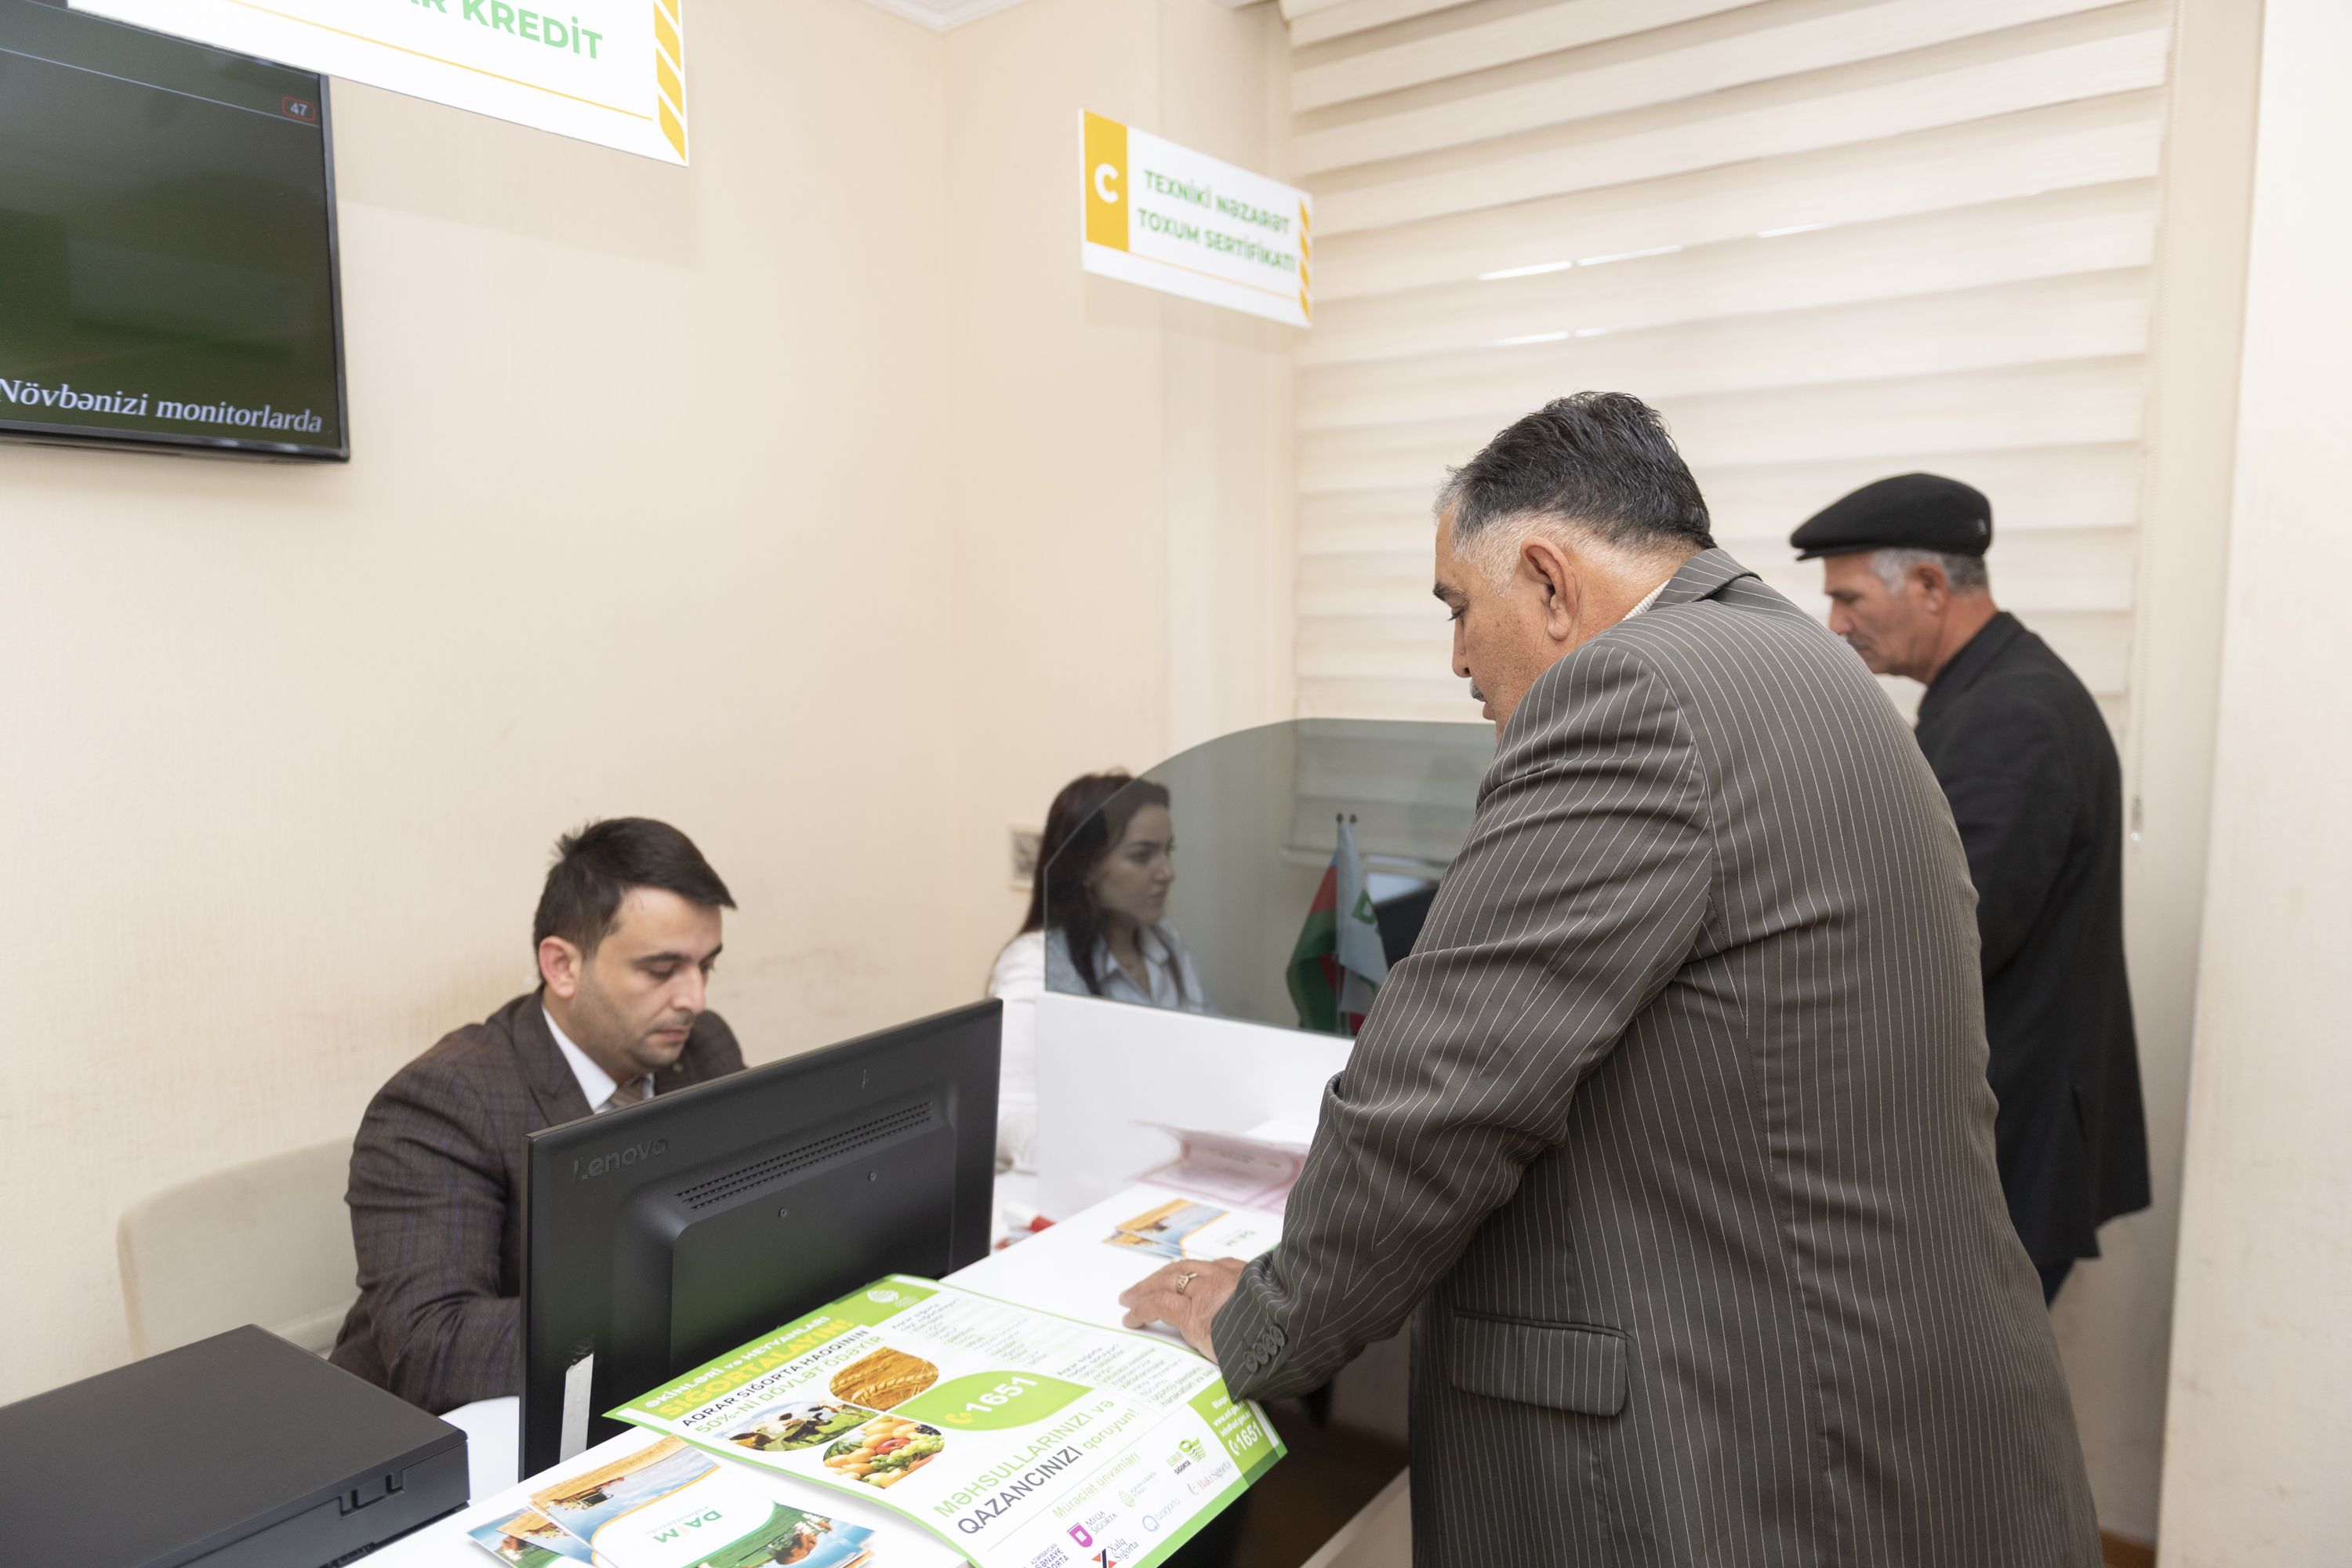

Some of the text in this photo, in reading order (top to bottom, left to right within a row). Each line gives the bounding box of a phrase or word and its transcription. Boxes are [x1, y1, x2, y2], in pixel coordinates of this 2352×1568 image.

[463, 0, 603, 59] KREDİT
[290, 102, 308, 116] 47
[1094, 163, 1119, 204] C
[1143, 169, 1291, 235] TEXNİKİ NƏZARƏT
[1137, 208, 1297, 273] TOXUM SERTİFİKATI
[0, 378, 322, 434] Növbənizi monitorlarda
[573, 1137, 668, 1182] Lenovo
[681, 1396, 740, 1427] AQRAR
[738, 1365, 804, 1400] SIĞORTA
[758, 1365, 826, 1402] DÖVLƏT
[965, 1376, 1037, 1412] 1651
[933, 1399, 1114, 1519] MƏHSULLARINIZI və
[1236, 1421, 1263, 1451] 1651
[956, 1407, 1140, 1534] QAZANCINIZI qoruyun!
[1045, 1555, 1069, 1568] ORTA
